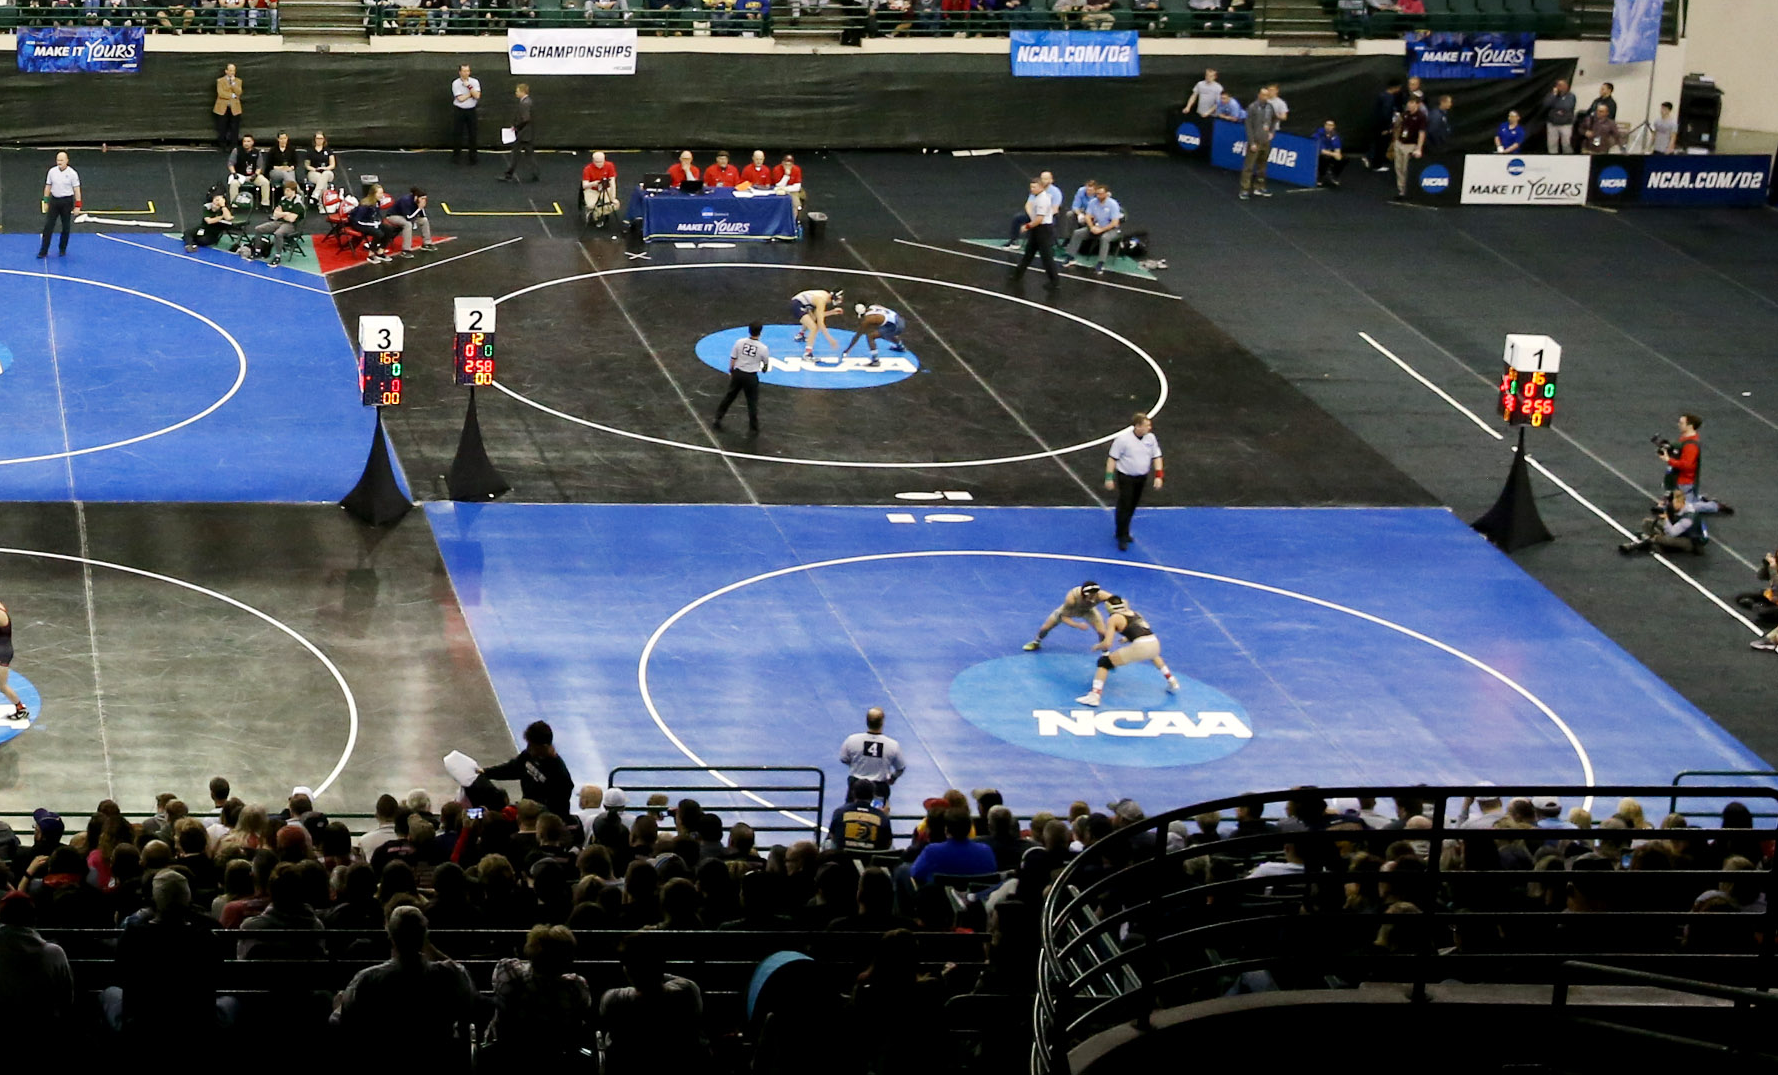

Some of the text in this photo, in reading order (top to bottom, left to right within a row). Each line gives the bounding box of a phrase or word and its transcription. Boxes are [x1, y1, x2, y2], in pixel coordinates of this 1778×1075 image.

[34, 39, 136, 61] MAKE IT YOURS
[529, 45, 633, 60] CHAMPIONSHIPS
[1016, 45, 1131, 63] NCAA.COM/D2
[1421, 44, 1525, 67] MAKE IT YOURS
[1469, 176, 1582, 200] MAKE IT YOURS
[1646, 170, 1763, 190] NCAA.COM/D2
[677, 223, 703, 232] MAKE
[714, 218, 750, 234] YOURS
[469, 310, 483, 331] 2
[377, 329, 392, 350] 3
[472, 333, 484, 345] 12
[379, 352, 400, 364] 162
[465, 344, 493, 357] 0 0
[742, 343, 757, 357] 22
[1532, 348, 1545, 370] 1
[391, 363, 401, 376] 0
[1524, 383, 1555, 397] 0 0
[1532, 413, 1542, 426] 0
[1033, 709, 1254, 738] NCAA
[866, 741, 880, 757] 4
